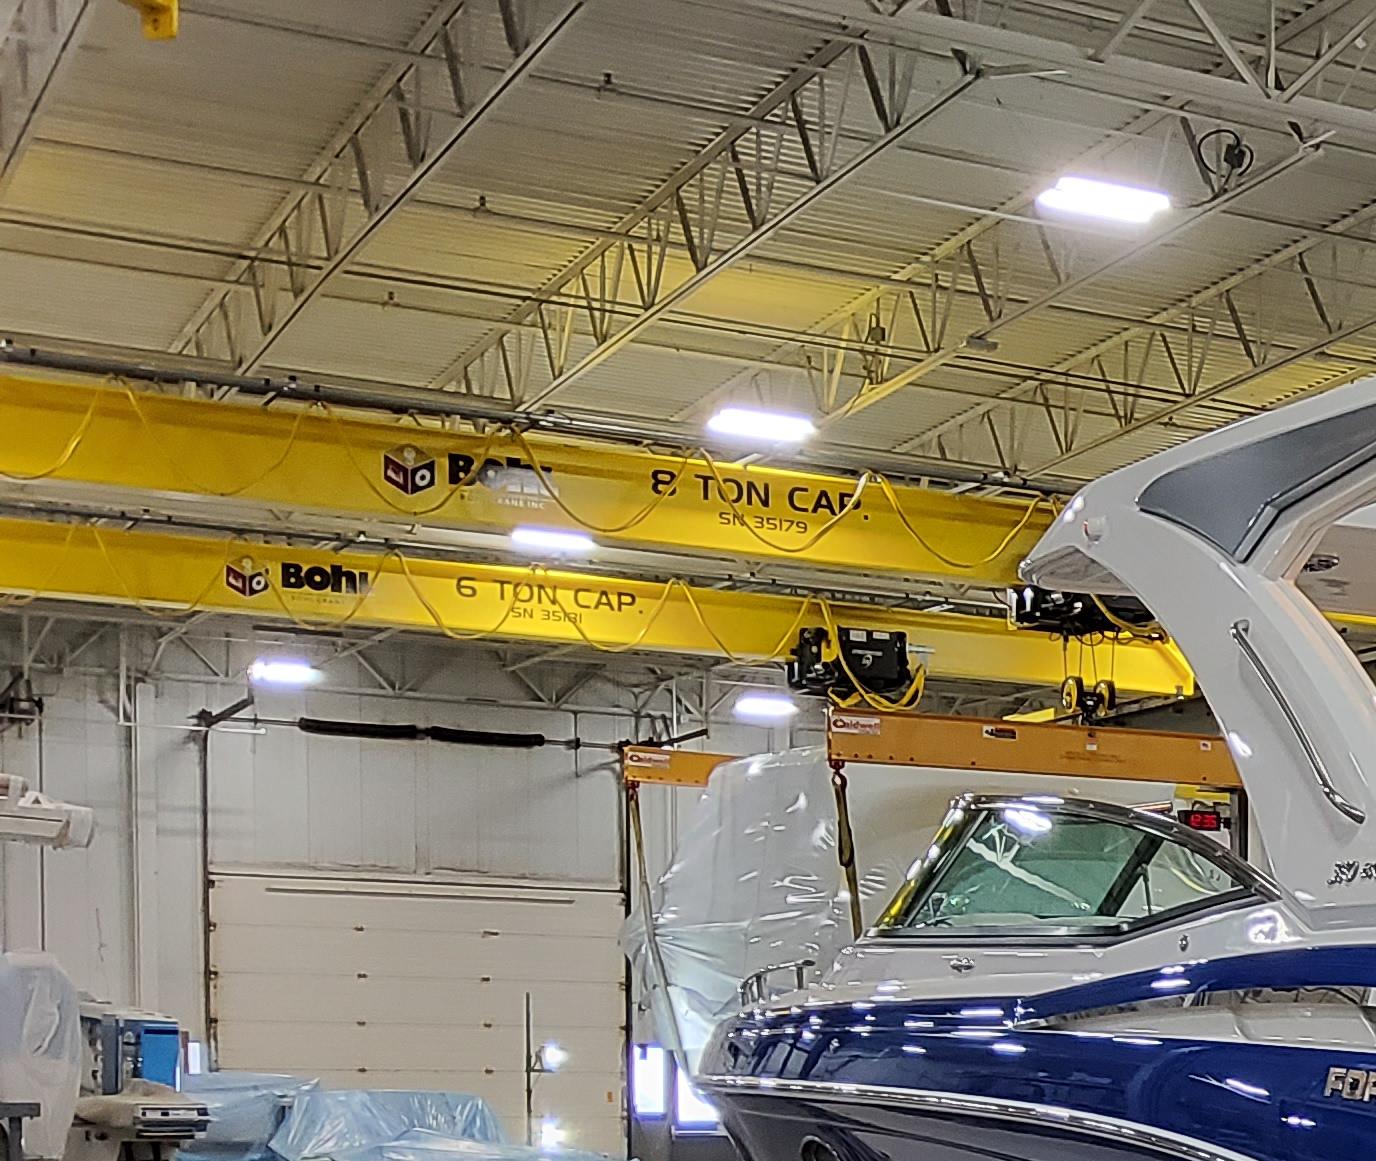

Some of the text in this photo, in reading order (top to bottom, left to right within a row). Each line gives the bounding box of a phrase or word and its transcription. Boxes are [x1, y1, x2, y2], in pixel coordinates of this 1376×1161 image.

[651, 469, 677, 497] 8
[694, 473, 770, 508] TON
[719, 511, 808, 533] SN 35179
[456, 577, 477, 598] 6
[494, 579, 557, 605] TON
[511, 607, 533, 618] SN
